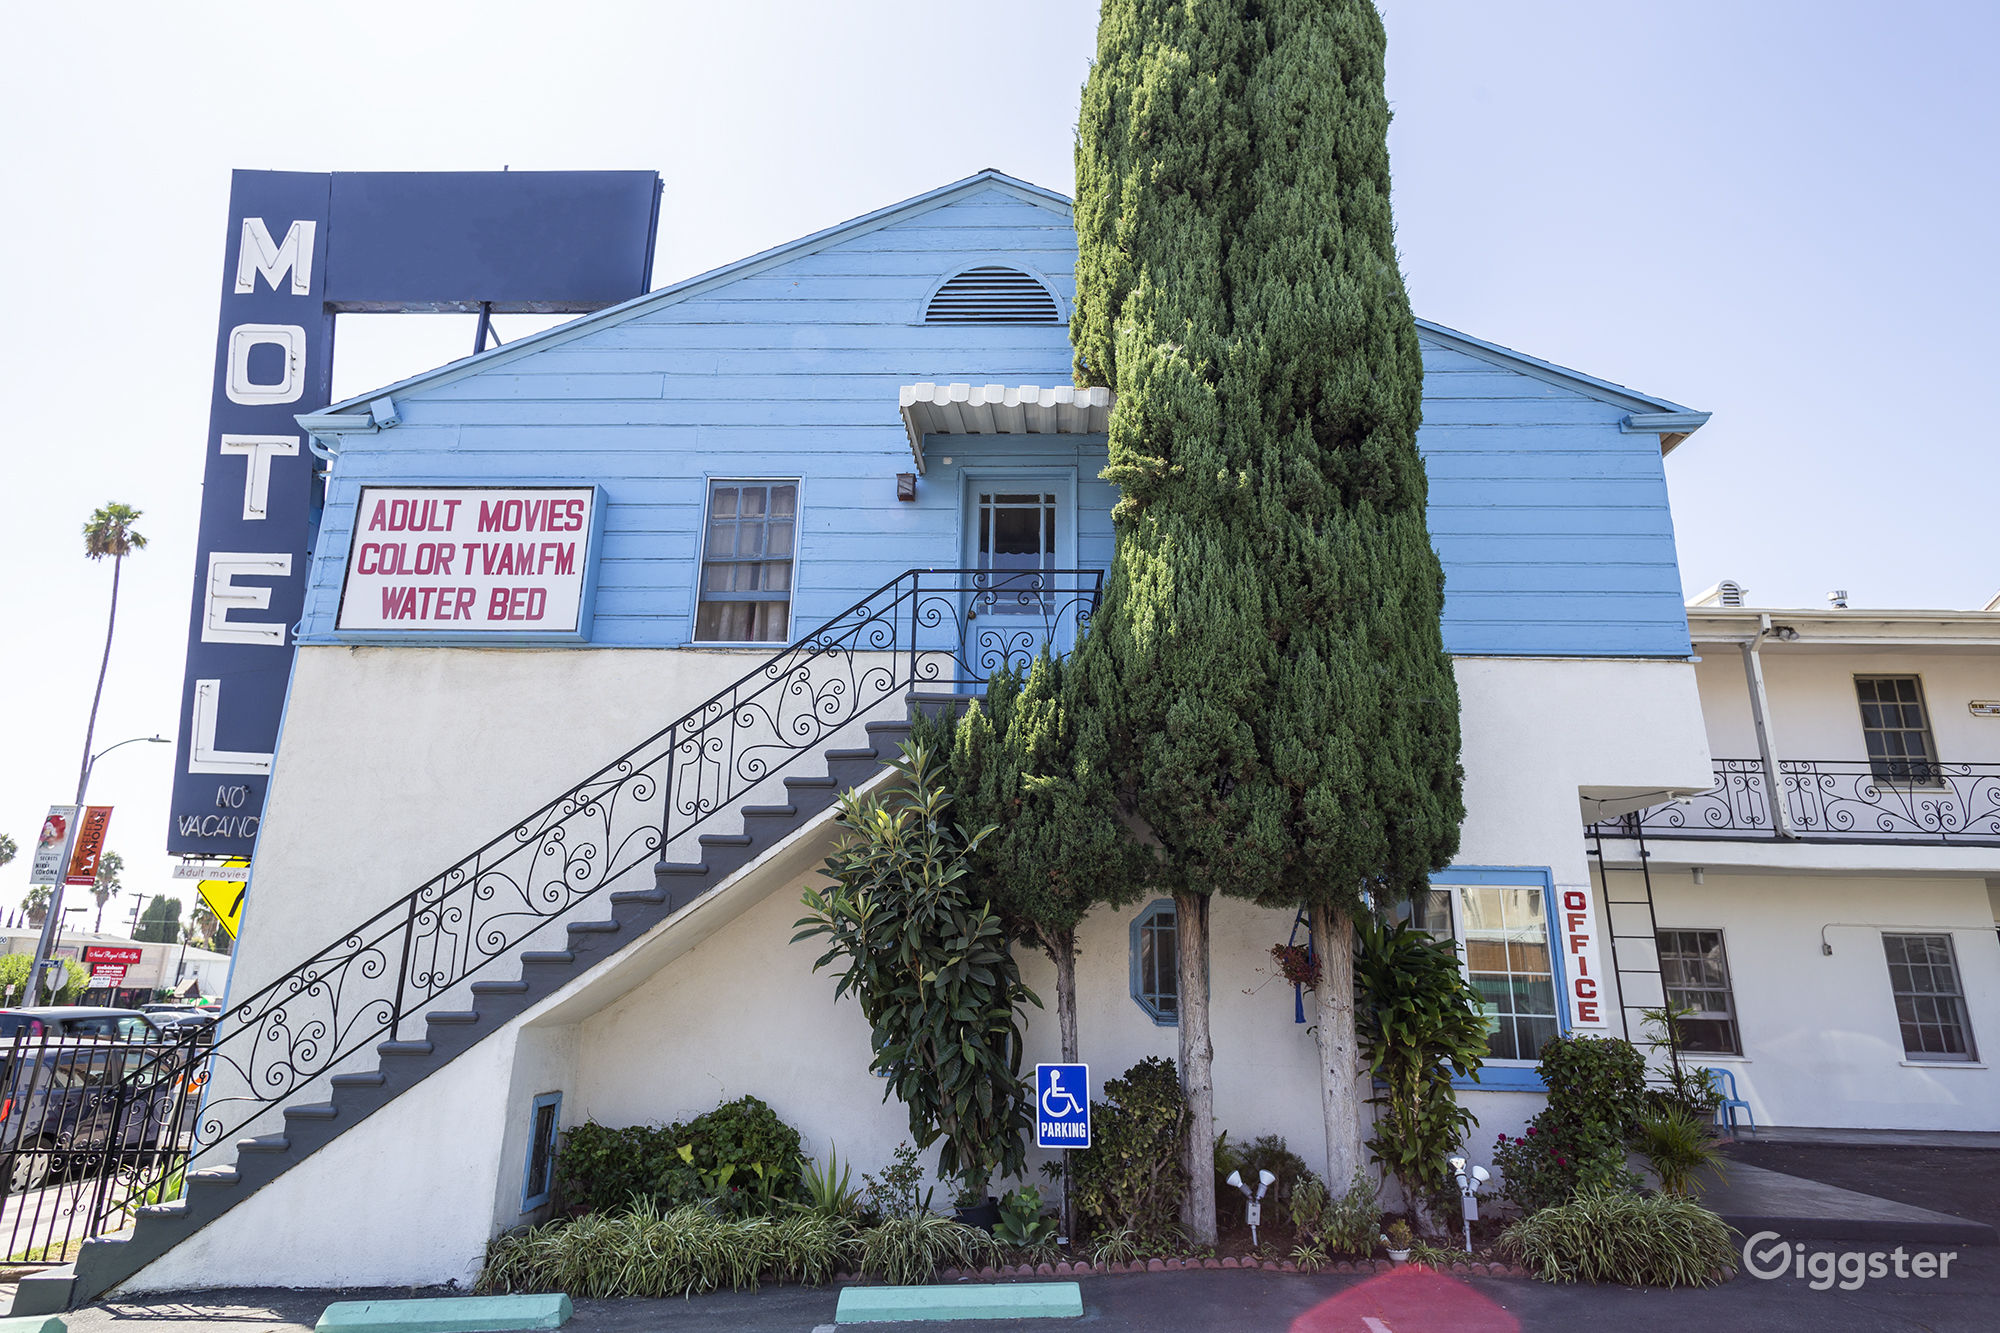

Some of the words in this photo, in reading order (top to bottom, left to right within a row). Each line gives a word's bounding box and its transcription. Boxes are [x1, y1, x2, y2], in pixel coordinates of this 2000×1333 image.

[188, 217, 316, 774] MOTEL
[368, 499, 461, 532] ADULT
[477, 499, 585, 533] MOVIES
[357, 542, 456, 575] COLOR
[382, 586, 476, 620] WATER
[487, 587, 547, 621] BED
[216, 784, 246, 808] NO
[178, 814, 261, 838] VACANC
[81, 810, 107, 876] PLAYHOUSE
[178, 868, 205, 877] Adult
[209, 869, 247, 879] movies
[1564, 890, 1600, 1023] OFFICE
[1041, 1122, 1087, 1138] PARKING
